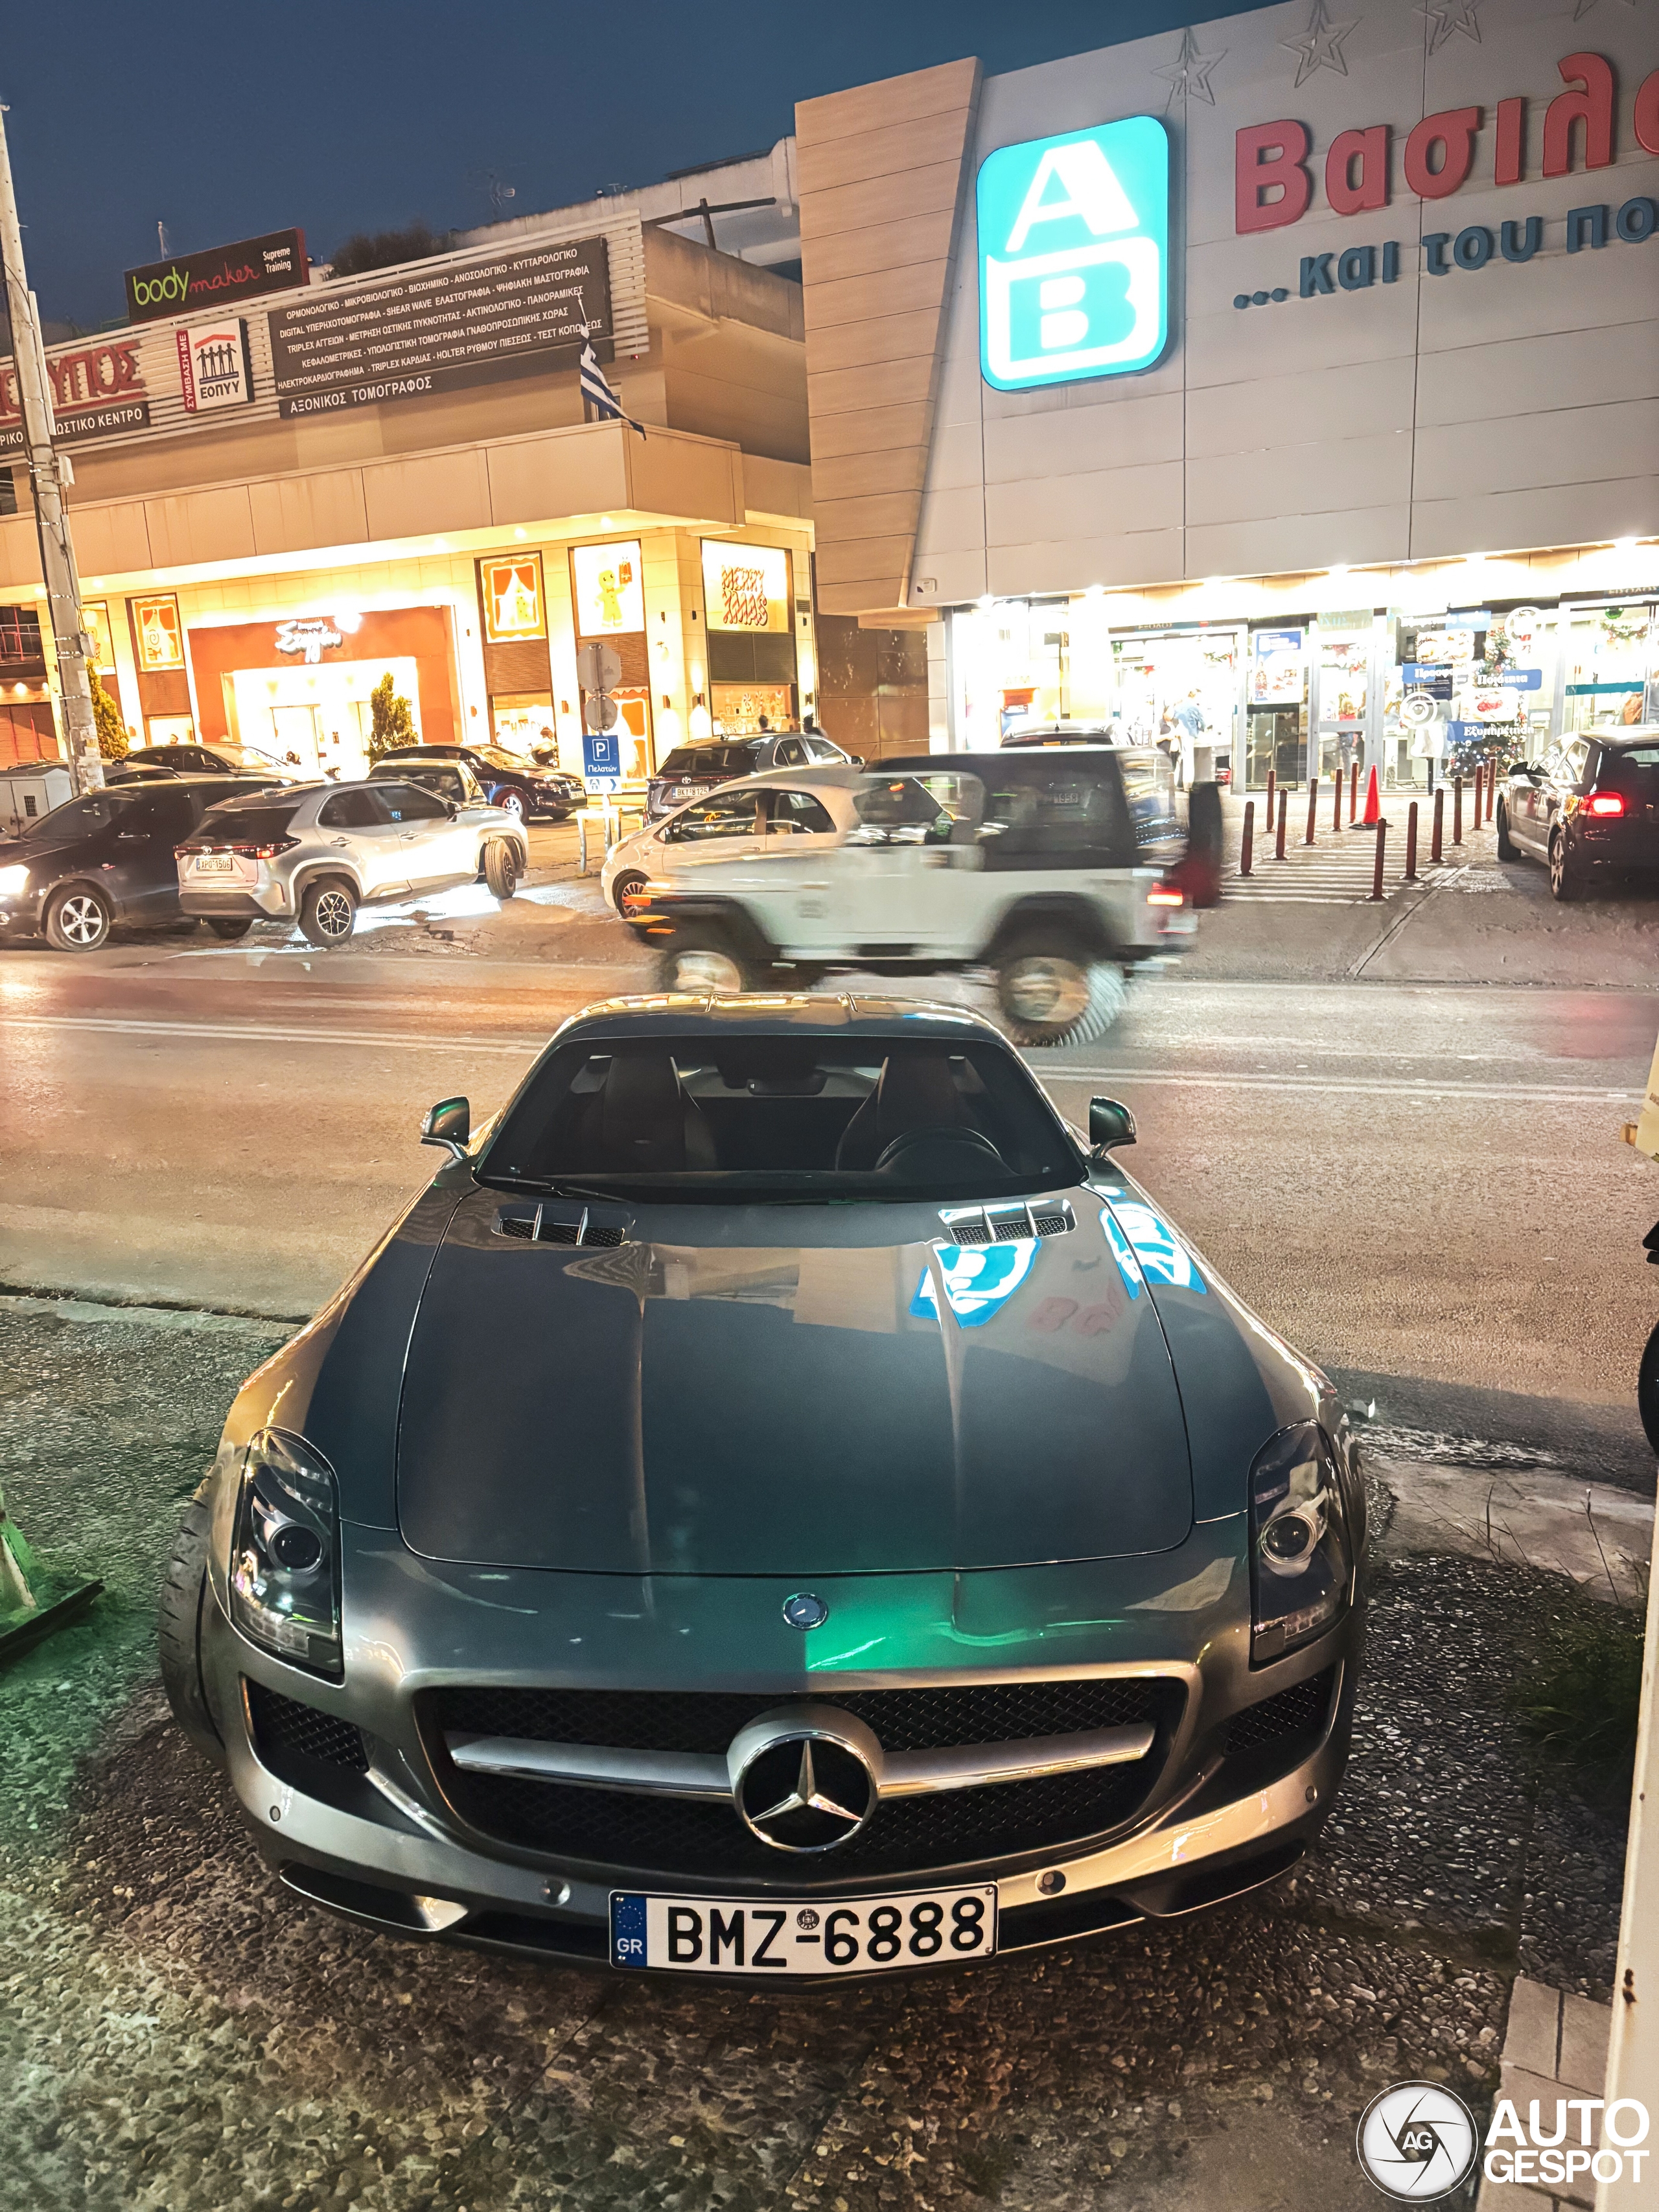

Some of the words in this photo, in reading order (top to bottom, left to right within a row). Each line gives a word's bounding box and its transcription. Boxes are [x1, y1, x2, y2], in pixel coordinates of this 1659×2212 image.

[262, 247, 291, 262] Supreme
[1422, 216, 1541, 276] του
[265, 260, 292, 274] Training
[286, 301, 340, 320] ΟΡΜΟΝΟΛΟΓΙΚΟ
[345, 287, 403, 308] ΜΙΚΡΟΒΙΟΛΟΓΙΚΟ
[408, 277, 448, 294] ΒΙΟΧΗΜΙΚΟ
[454, 264, 507, 283] ΑΝΟΣΟΛΟΓΙΚΟ
[513, 248, 577, 271] ΚΥΤΤΑΡΟΛΟΓΙΚΟ
[279, 326, 305, 338] DIGITAL
[306, 310, 382, 333] ΥΠΕΡΗΧΟΤΟΜΟΓΡΑΦΙΑ
[386, 303, 411, 316] SHEAR
[412, 299, 432, 311] WAVE
[435, 286, 491, 306] ΕΛΑΣΤΟΓΡΑΦΙΑ
[496, 277, 532, 292] ΨΗΦΙΑΚΗ
[534, 265, 590, 285] ΜΑΣΤΟΓΡΑΦΙΑ
[287, 341, 314, 354] TRIPLEX
[316, 335, 344, 349] ΑΓΓΕΙΩΝ
[349, 327, 381, 342] ΜΕΤΡΗΣΗ
[382, 321, 412, 334] ΟΣΤΙΚΗΣ
[413, 311, 461, 329] ΠΥΚΝΟΤΗΤΑΣ
[467, 299, 522, 318] ΑΚΤΙΝΟΛΟΓΙΚΟ
[528, 286, 584, 305] ΠΑΝΟΡΑΜΙΚΕΣ
[179, 334, 188, 352] ΜΕ
[302, 349, 363, 369] ΚΕΦΑΛΟΜΕΤΡΙΚΕΣ
[367, 338, 417, 356] ΥΠΟΛΟΓΙΣΤΙΚΗ
[418, 329, 465, 346] ΤΟΜΟΓΡΑΦΙΑ
[467, 312, 541, 336] ΓΝΑΘΟΠΡΟΣΩΠΙΚΗΣ
[542, 307, 568, 321] ΧΩΡΑΣ
[371, 358, 400, 372] TRIPLEX
[401, 353, 432, 367] ΚΑΡΔΙΑΣ
[437, 347, 465, 360] HOLTER
[467, 340, 498, 355] ΡΥΘΜΟΥ
[500, 333, 531, 347] ΠΙΕΣΕΩΣ
[538, 328, 557, 340] ΤΕΣΤ
[559, 319, 602, 336] ΚΟΠΩΕΩΣ
[181, 354, 194, 408] ΣΥΜΒΑΣΗ
[200, 380, 240, 399] ΕΟΠΥΥ
[290, 392, 347, 413] ΑΞΟΝΙΚΟΣ
[352, 376, 432, 402] ΤΟΜΟΓΡΑΦΟΣ
[57, 417, 95, 436] ΩΣΤΙΚΟ
[98, 408, 143, 427] ΚΕΝΤΡΟ
[721, 565, 765, 593] MERRY
[722, 590, 768, 626] XMAS
[596, 742, 605, 758] P
[588, 764, 617, 773] Πελατών
[617, 1938, 643, 1955] GR
